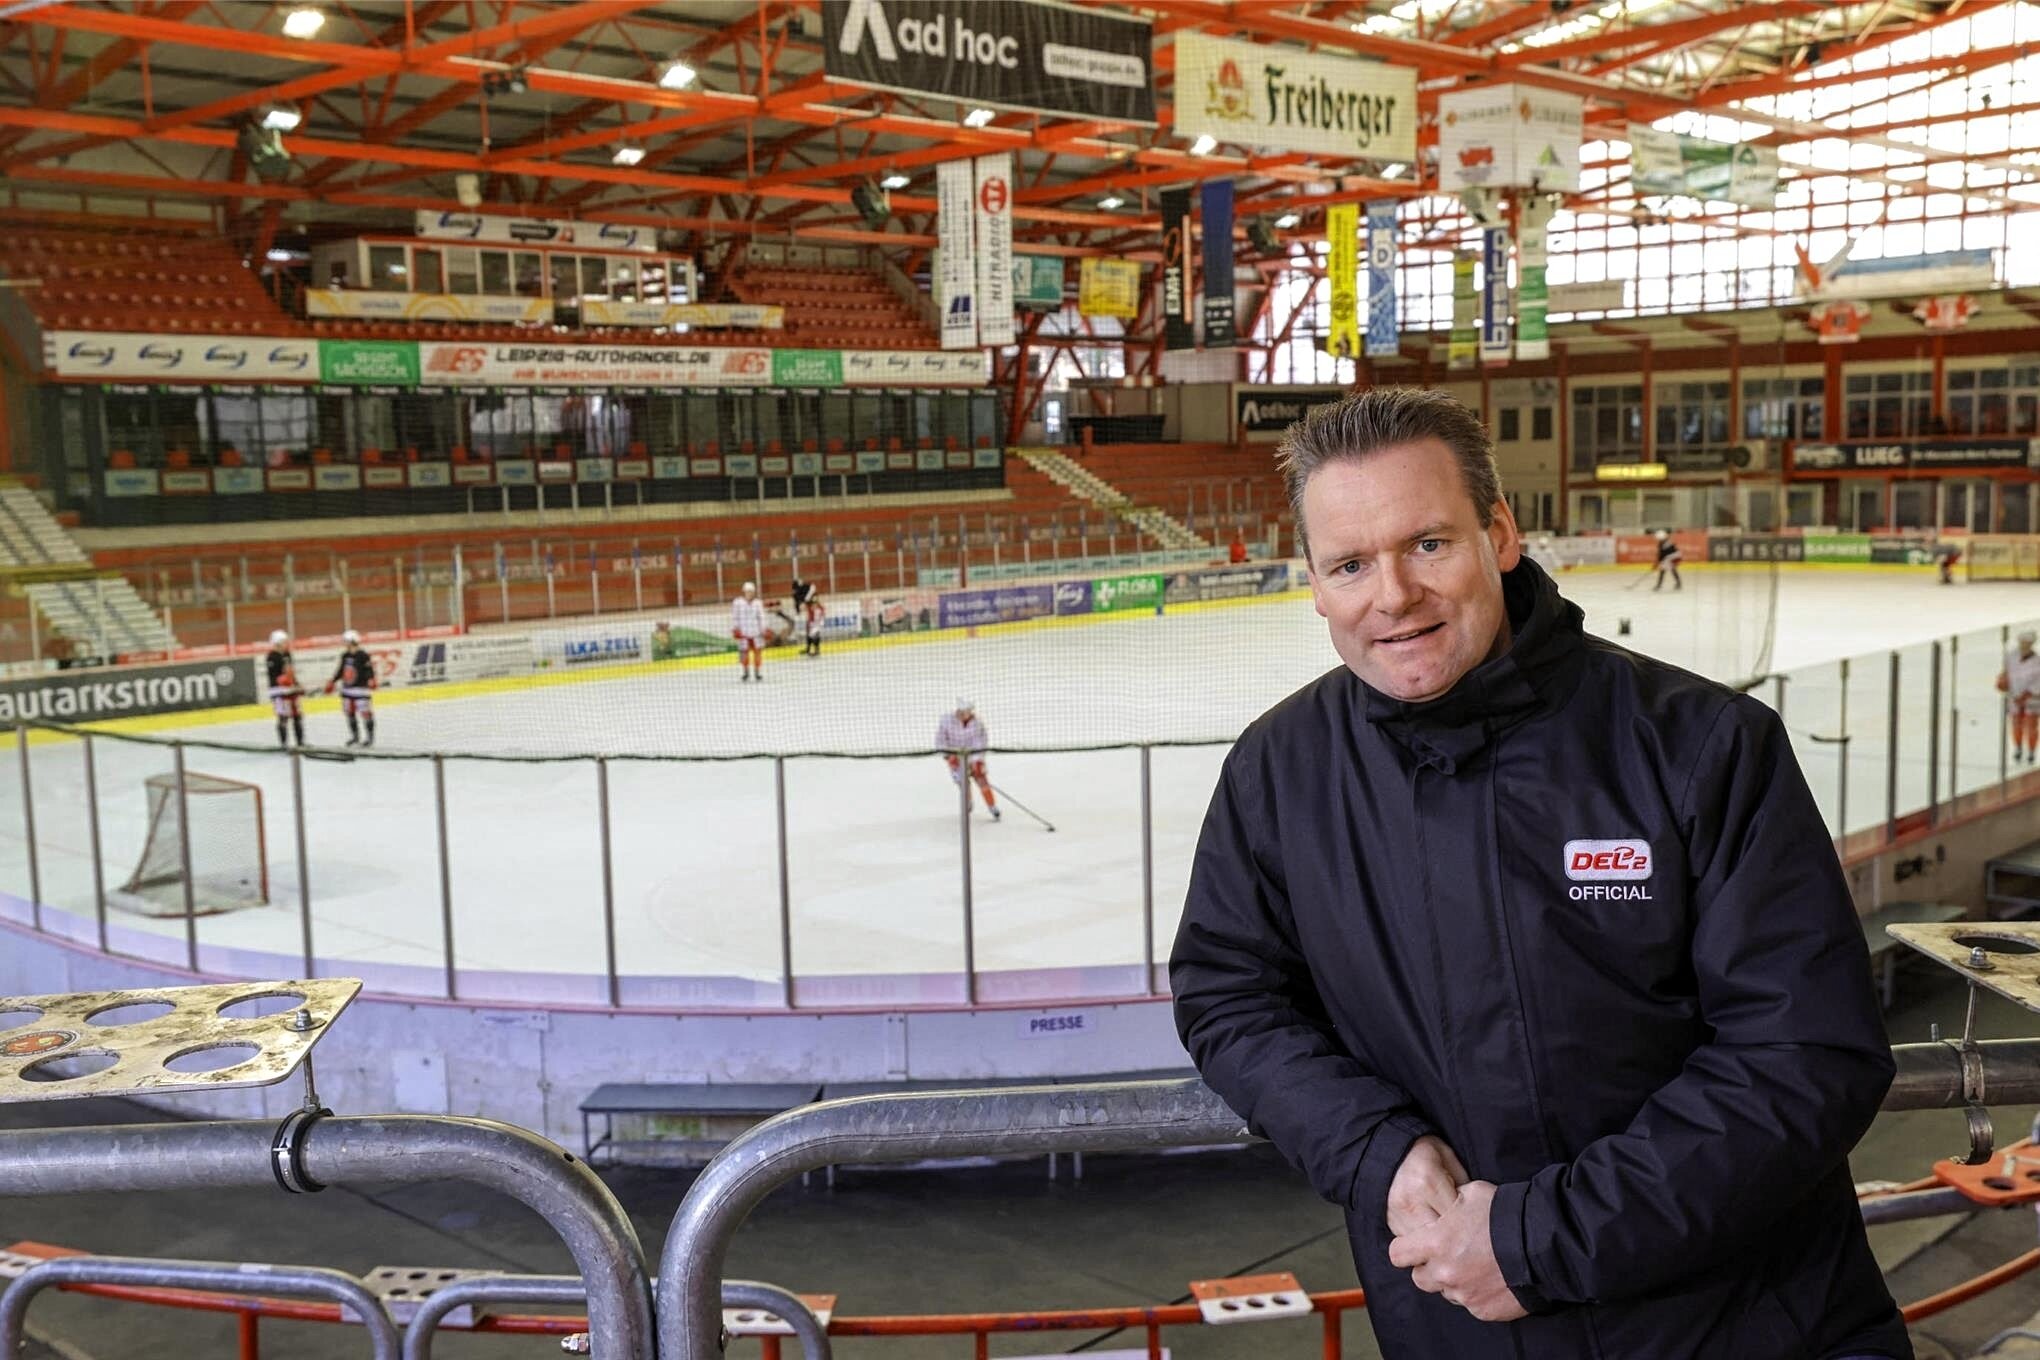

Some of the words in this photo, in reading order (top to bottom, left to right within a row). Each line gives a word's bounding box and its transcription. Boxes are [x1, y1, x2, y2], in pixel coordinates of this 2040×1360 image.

[897, 13, 947, 57] ad
[955, 17, 1019, 69] hoc
[1264, 63, 1396, 148] Freiberger
[496, 348, 711, 365] LEIPZIG-AUTOHANDEL.DE
[1714, 543, 1802, 559] HIRSCH
[1117, 578, 1158, 596] FLORA
[1568, 885, 1653, 900] OFFICIAL
[1030, 1015, 1084, 1032] PRESSE
